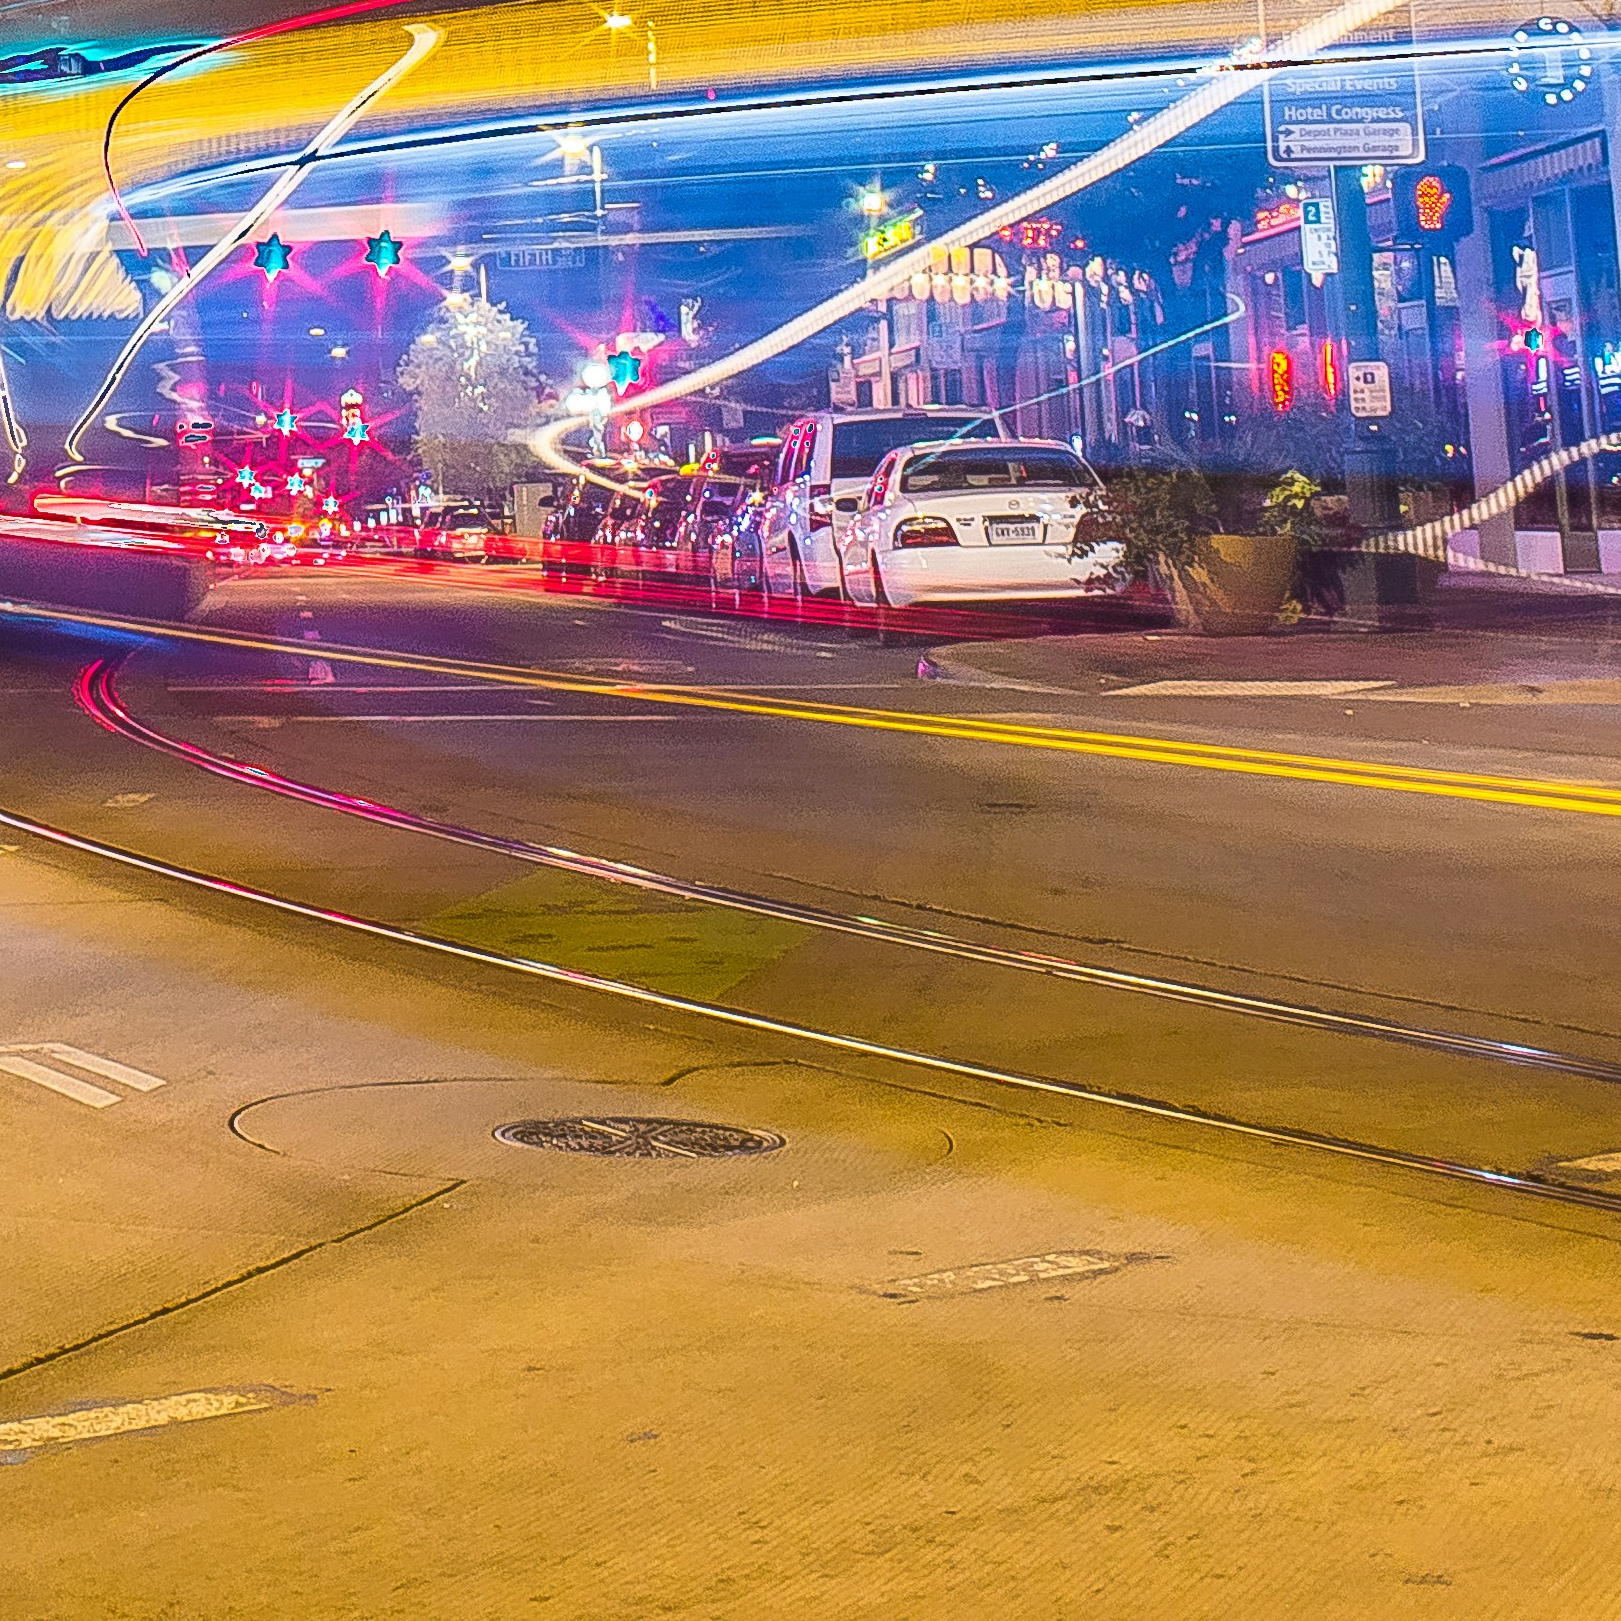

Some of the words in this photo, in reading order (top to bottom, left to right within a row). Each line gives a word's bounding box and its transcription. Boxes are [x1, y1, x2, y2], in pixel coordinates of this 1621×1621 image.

[1345, 77, 1399, 90] Events
[1284, 104, 1327, 121] Hotel
[1331, 104, 1405, 122] Congress
[1299, 126, 1331, 138] Depot
[1333, 126, 1360, 137] Plaza
[1363, 126, 1401, 139] Garage
[1299, 143, 1360, 155] Pennington
[1362, 143, 1400, 154] Garage
[510, 249, 554, 267] FIFTH
